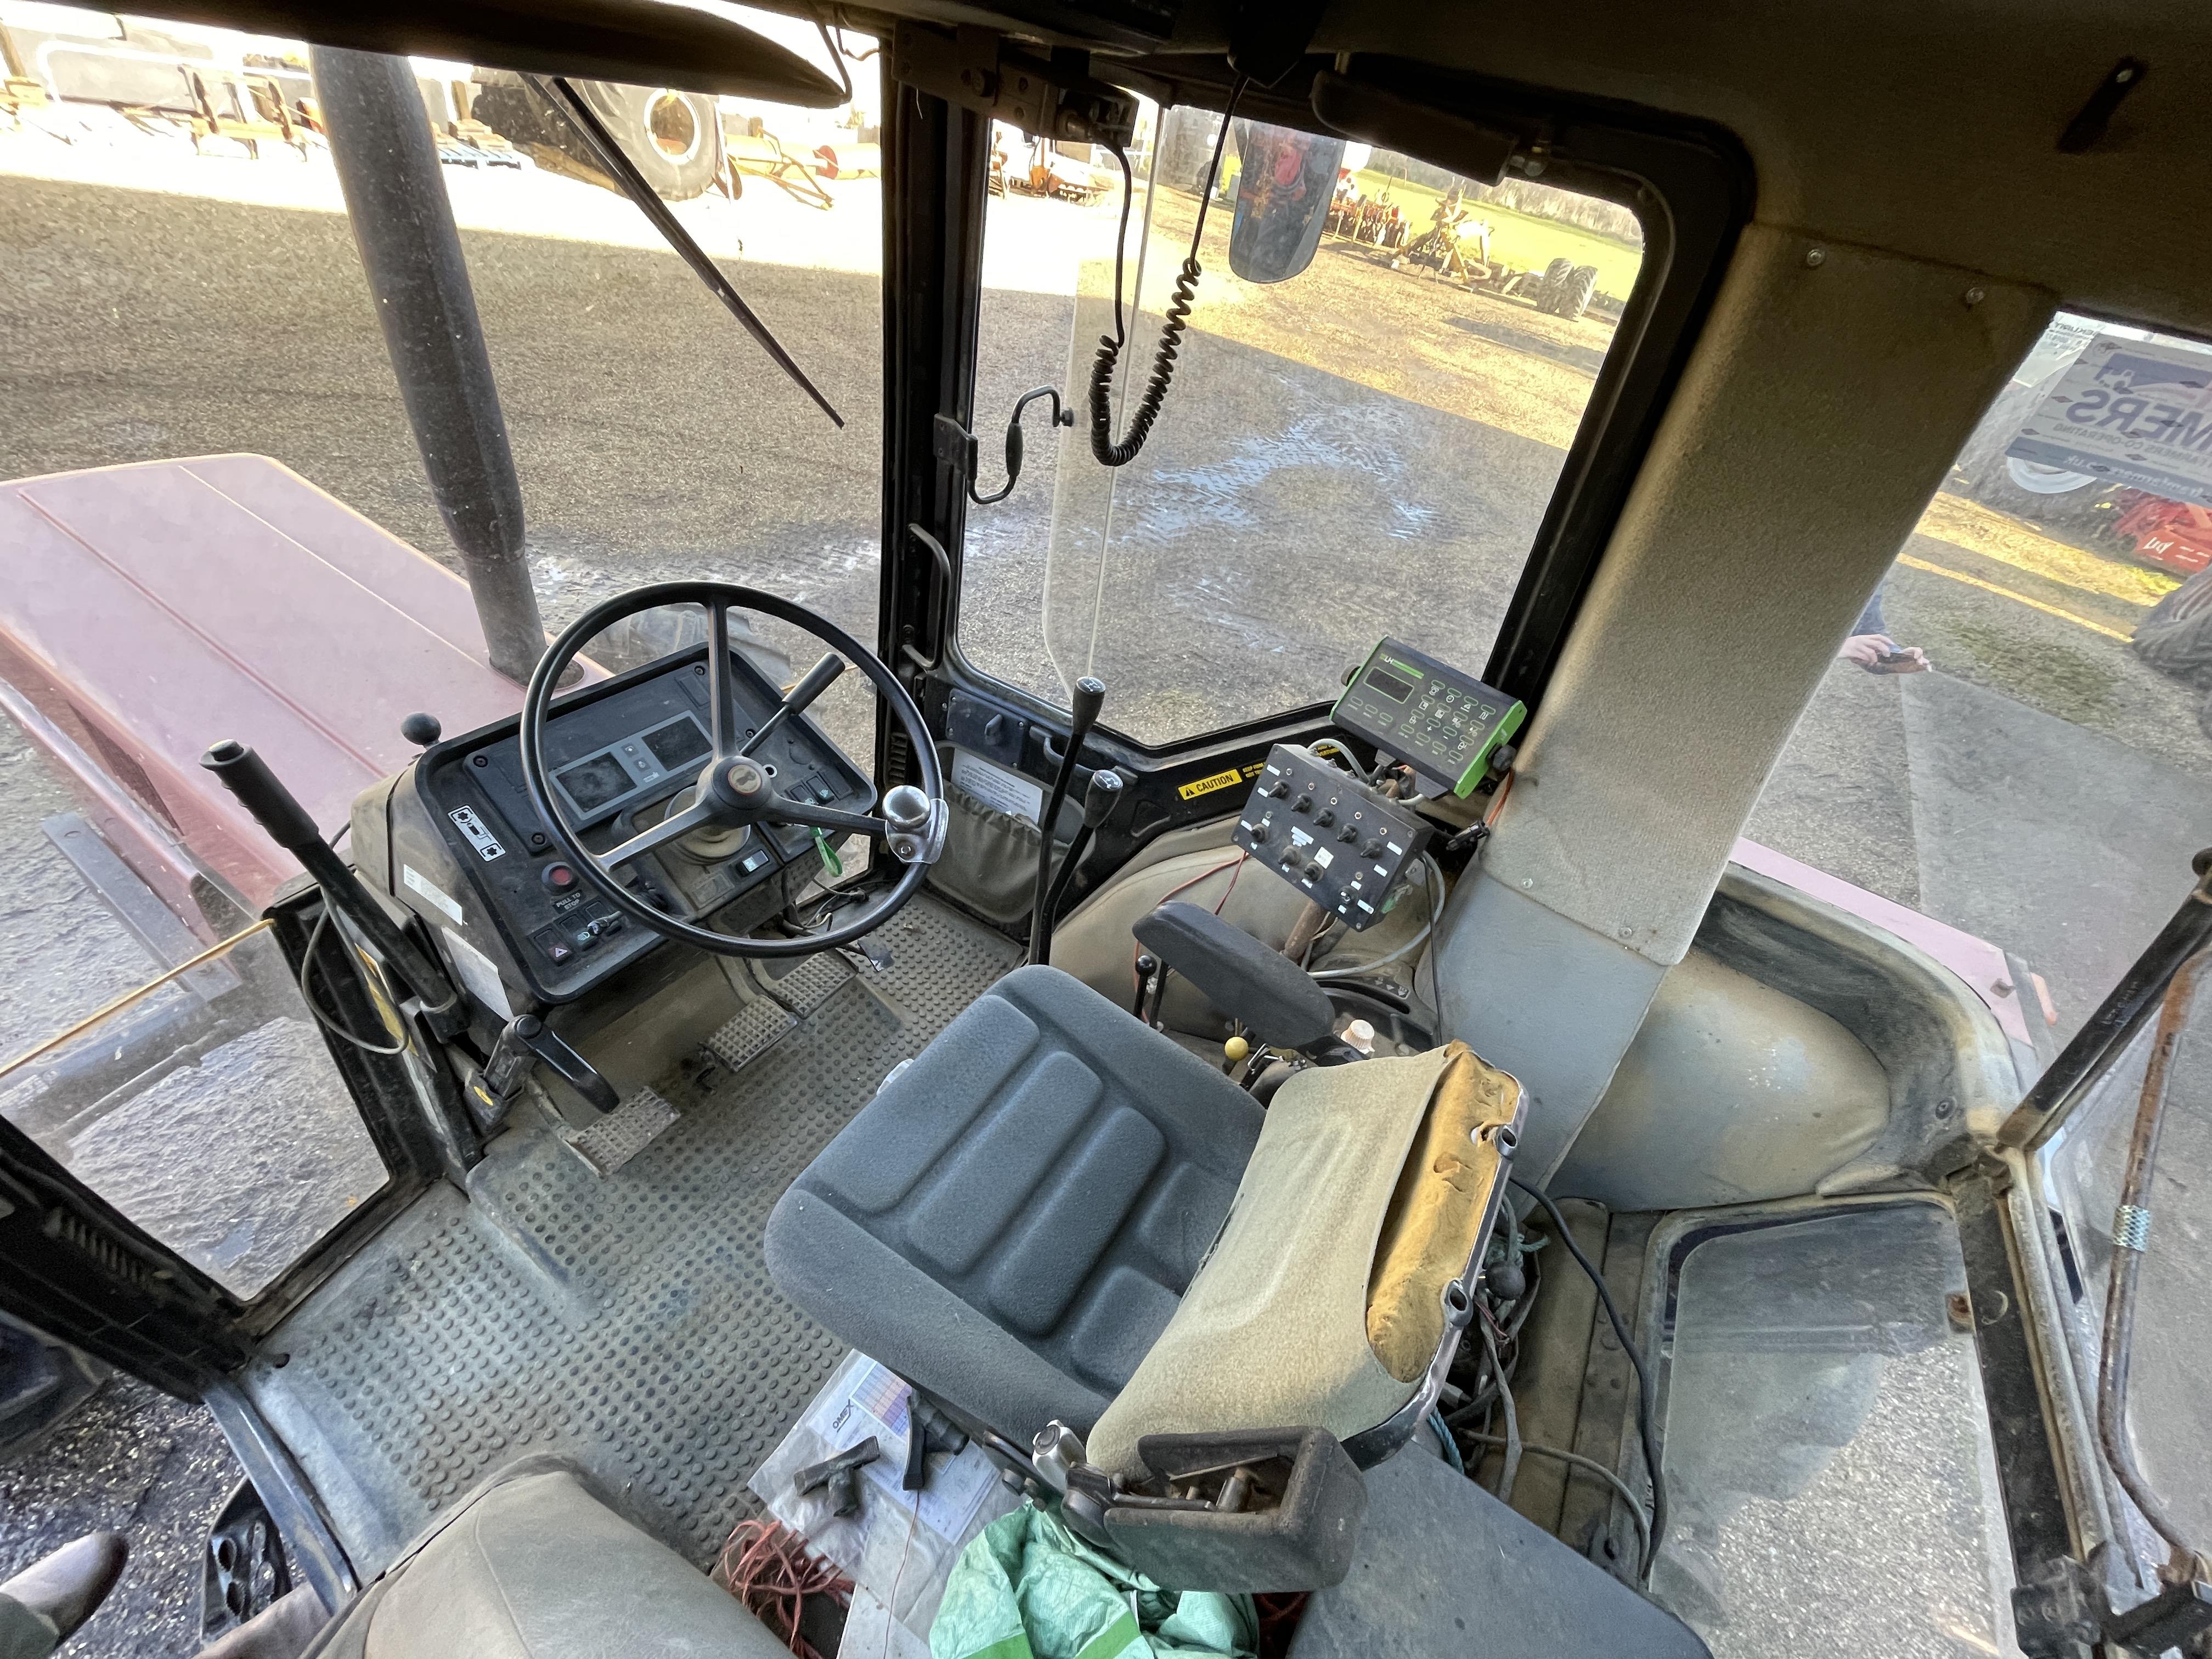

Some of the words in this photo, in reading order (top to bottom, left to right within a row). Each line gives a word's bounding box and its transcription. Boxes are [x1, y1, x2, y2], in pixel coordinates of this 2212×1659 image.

[1196, 774, 1234, 792] CAUTION
[556, 898, 571, 907] PULL
[832, 1399, 854, 1430] OMEX
